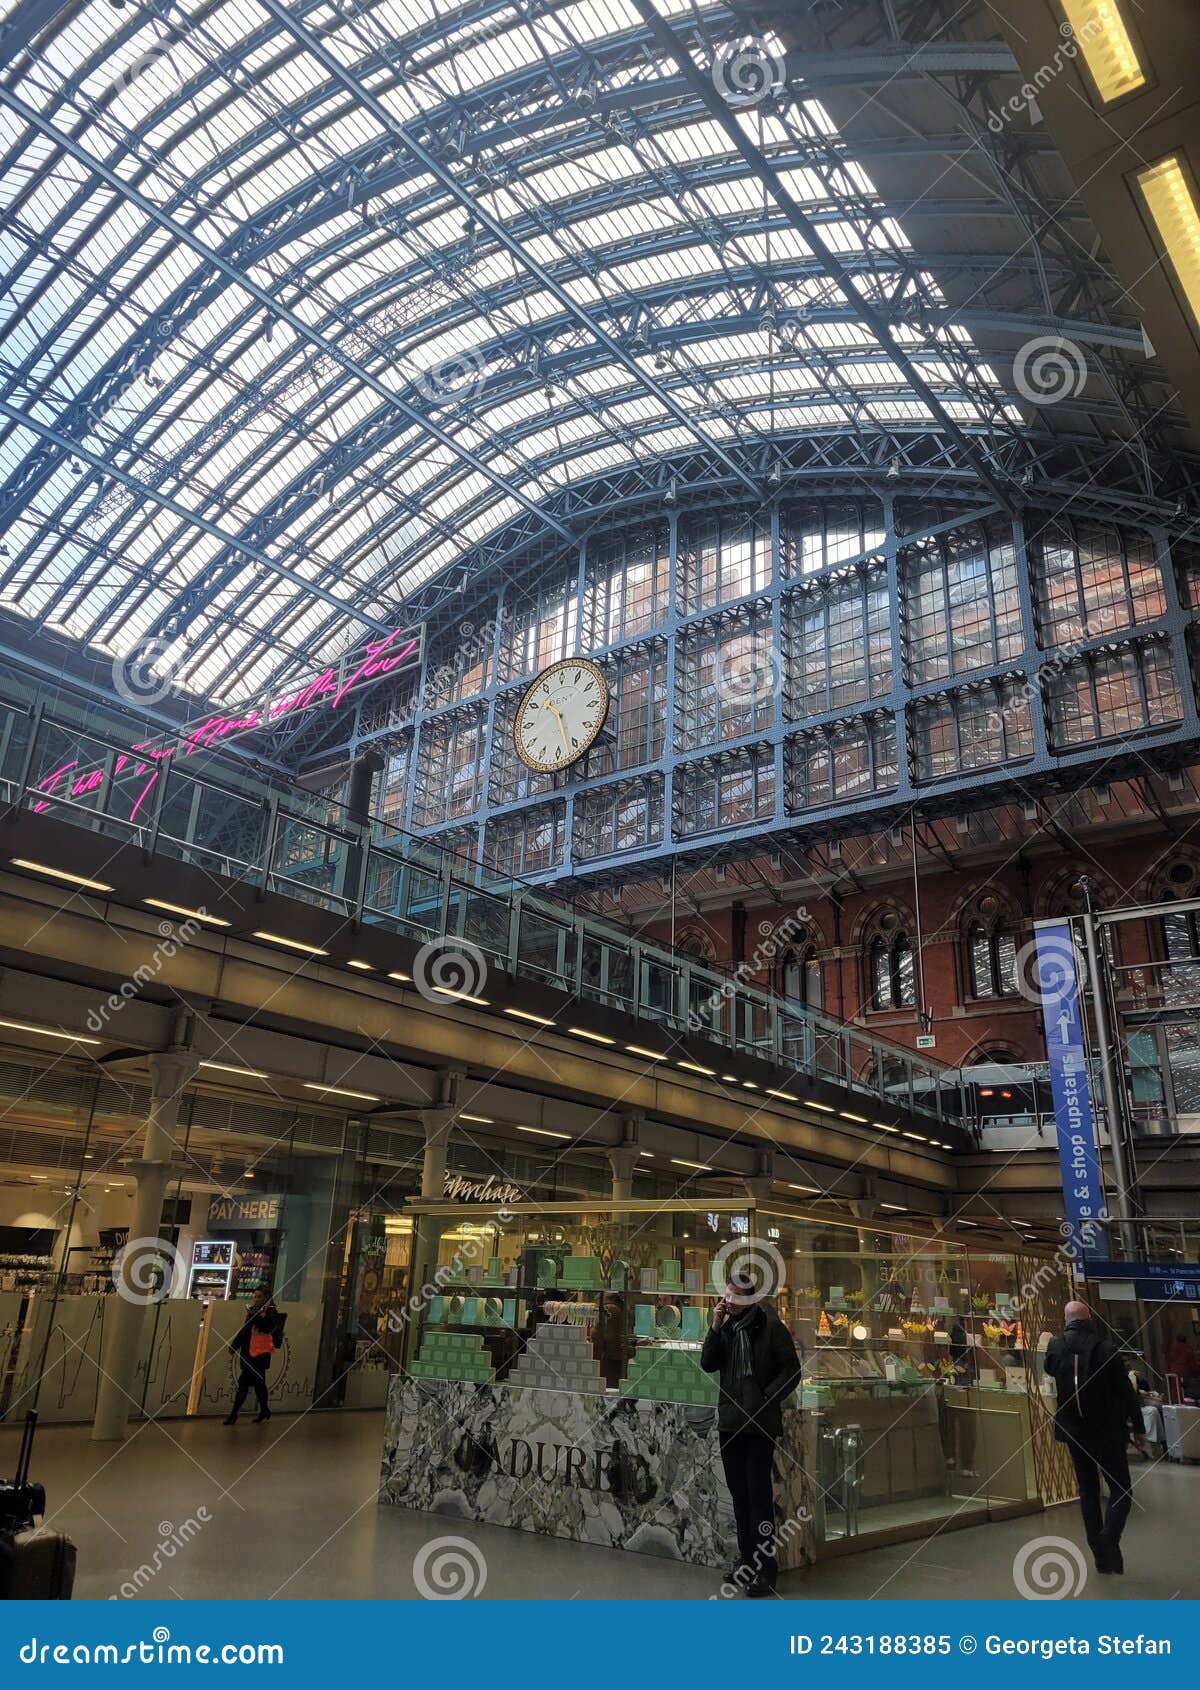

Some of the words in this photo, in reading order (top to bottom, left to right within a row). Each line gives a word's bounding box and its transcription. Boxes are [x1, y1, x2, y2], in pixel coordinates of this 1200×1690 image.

[1061, 1054, 1083, 1129] upstairs
[1070, 1134, 1087, 1178] shop
[443, 1169, 522, 1204] aperchase
[1073, 1185, 1090, 1199] &
[208, 1203, 234, 1220] PAY
[239, 1200, 277, 1219] HERE
